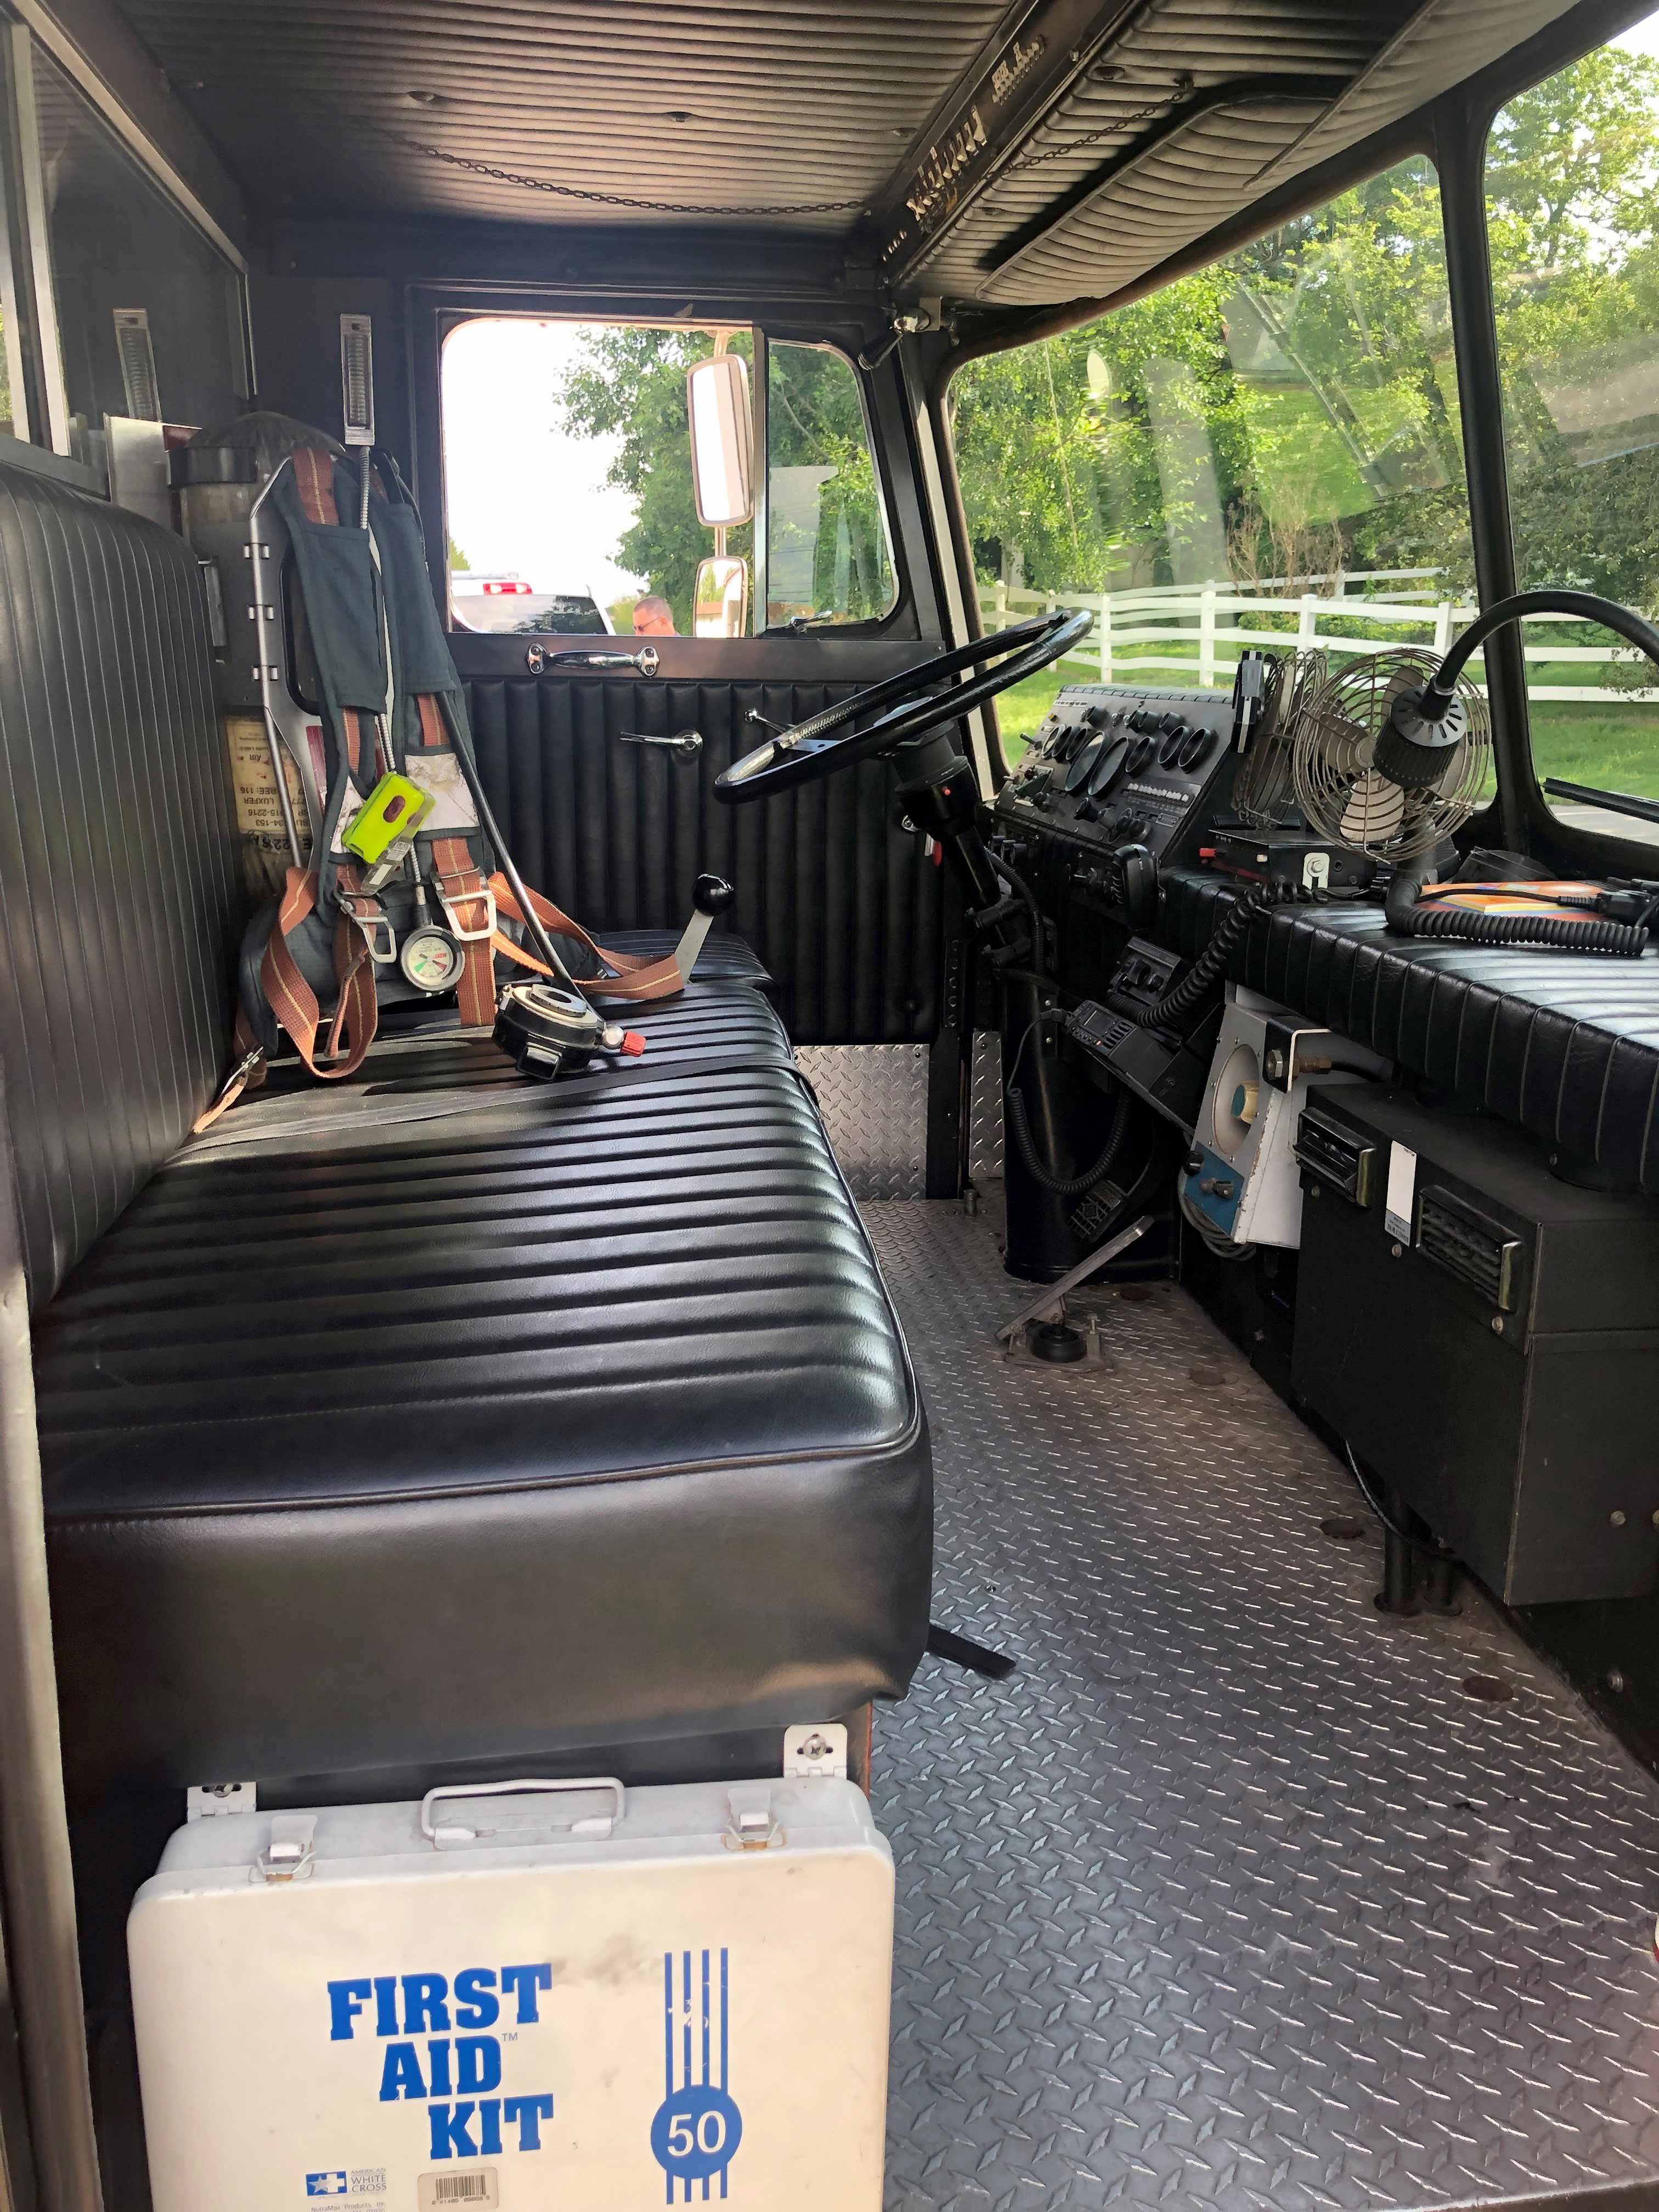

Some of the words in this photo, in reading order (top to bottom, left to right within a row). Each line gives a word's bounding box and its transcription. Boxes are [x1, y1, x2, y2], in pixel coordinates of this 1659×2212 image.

[327, 1962, 552, 2041] FIRST
[379, 2035, 501, 2102] AID
[428, 2093, 554, 2160] KIT
[667, 2110, 727, 2156] 50
[351, 2174, 387, 2185] WHITE
[352, 2183, 387, 2193] CROSS
